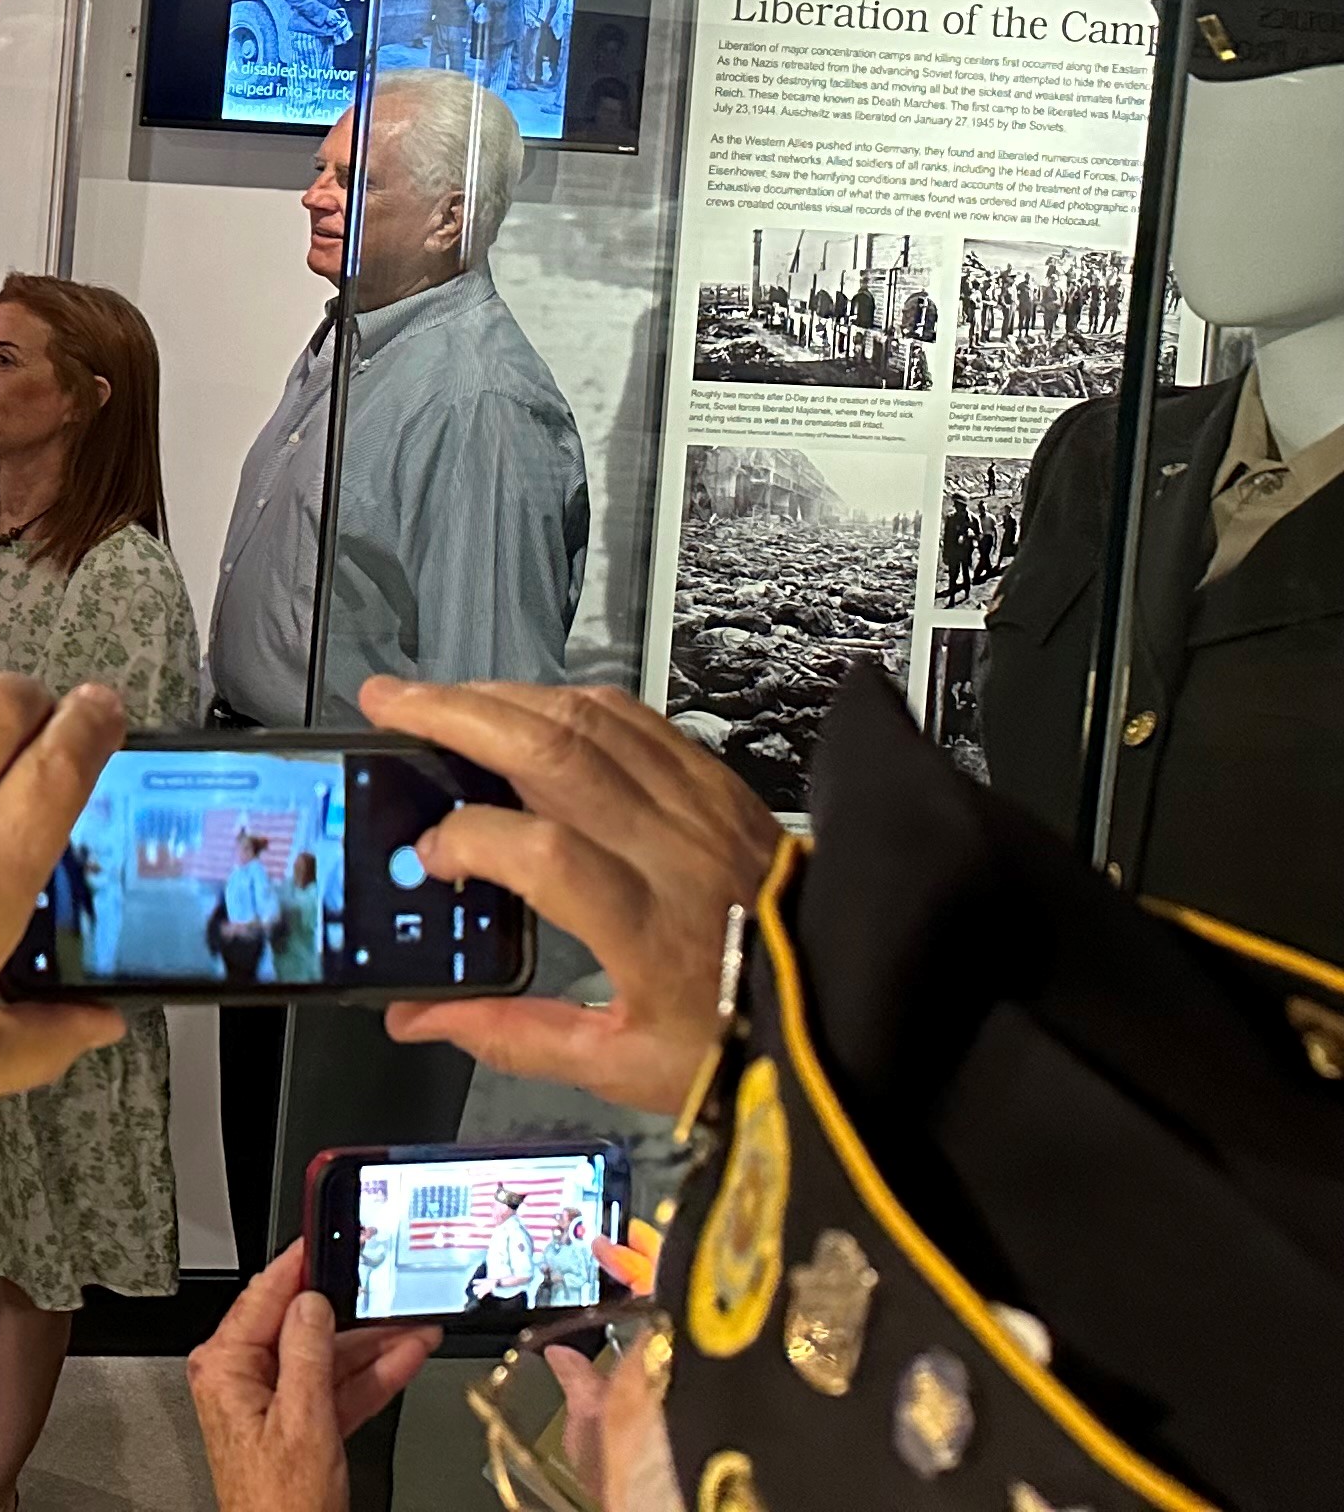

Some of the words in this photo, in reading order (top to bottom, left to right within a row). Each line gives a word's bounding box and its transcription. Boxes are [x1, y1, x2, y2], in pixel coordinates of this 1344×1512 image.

[943, 3, 983, 36] of
[992, 6, 1047, 40] the
[718, 39, 766, 53] Liberation
[769, 42, 779, 53] of
[781, 46, 809, 57] major
[811, 47, 876, 59] concentration
[879, 51, 911, 63] camps
[914, 53, 932, 63] and
[241, 61, 297, 77] disabled
[300, 65, 357, 81] Survivor
[226, 81, 273, 97] helped
[276, 83, 303, 97] into
